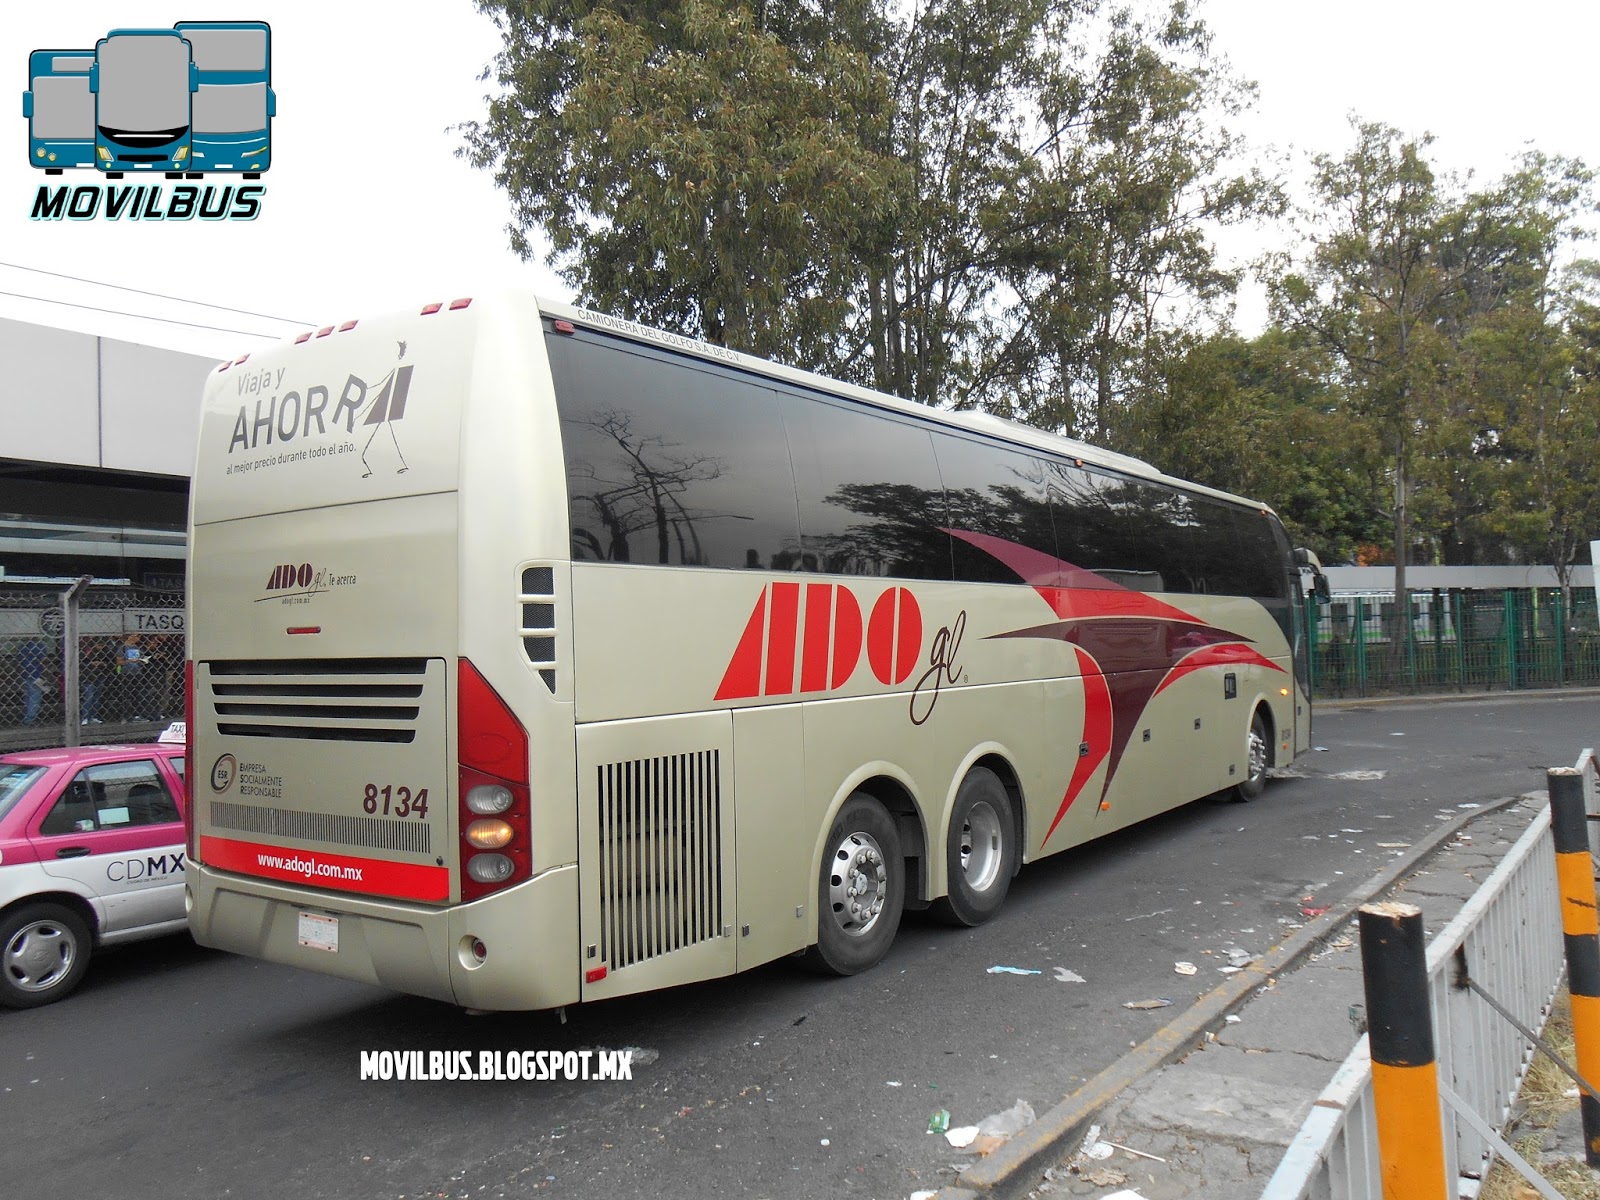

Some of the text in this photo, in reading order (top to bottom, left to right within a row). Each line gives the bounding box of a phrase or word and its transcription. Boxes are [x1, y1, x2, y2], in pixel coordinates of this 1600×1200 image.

[577, 309, 742, 363] CAMIONERA DEL GOLFO S.A. DE C.V.
[238, 367, 286, 396] Viaja y
[226, 441, 356, 475] al mejor precio durante todo el año.
[266, 563, 313, 590] ADO
[329, 573, 335, 586] Te
[336, 575, 357, 586] acerca
[135, 615, 184, 630] TASQ
[713, 581, 922, 701] ADO
[171, 725, 184, 733] TAXI
[218, 770, 228, 779] ESR
[240, 763, 266, 773] EMPRESA
[240, 774, 282, 786] SOCIALMENTE
[240, 786, 282, 798] RESPONSABLE
[363, 783, 428, 819] 8134
[107, 852, 185, 881] CDMX
[257, 854, 363, 881] www.adogl.com.mx
